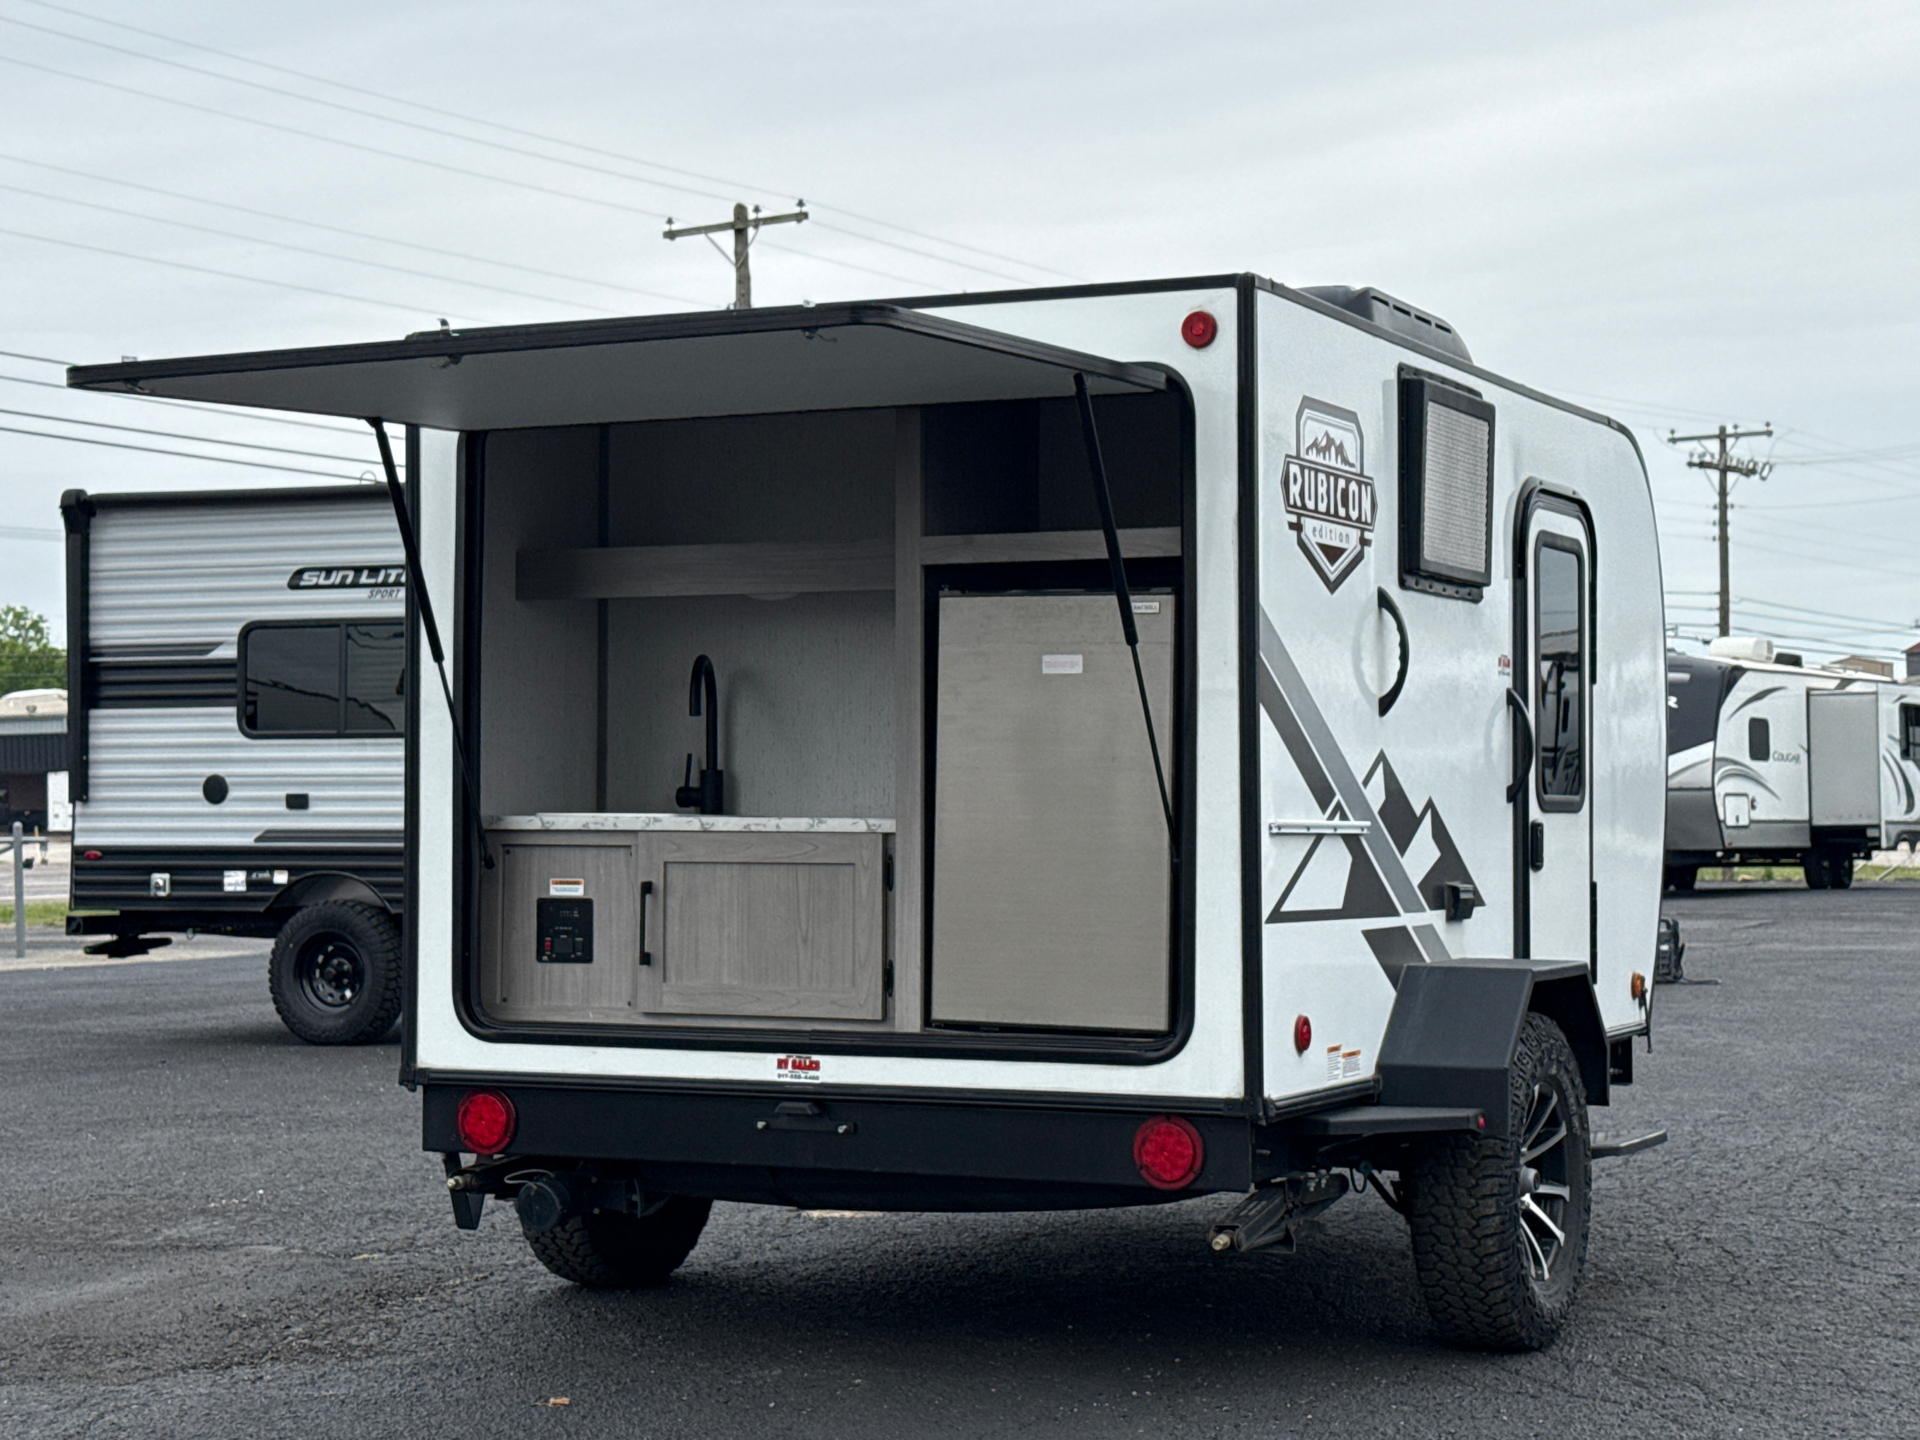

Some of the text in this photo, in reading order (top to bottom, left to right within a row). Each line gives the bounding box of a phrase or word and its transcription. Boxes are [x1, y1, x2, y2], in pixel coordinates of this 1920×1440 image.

[1288, 463, 1372, 524] RUBICON
[1312, 525, 1350, 545] edition
[300, 570, 355, 586] SUN
[367, 588, 401, 599] SPORT
